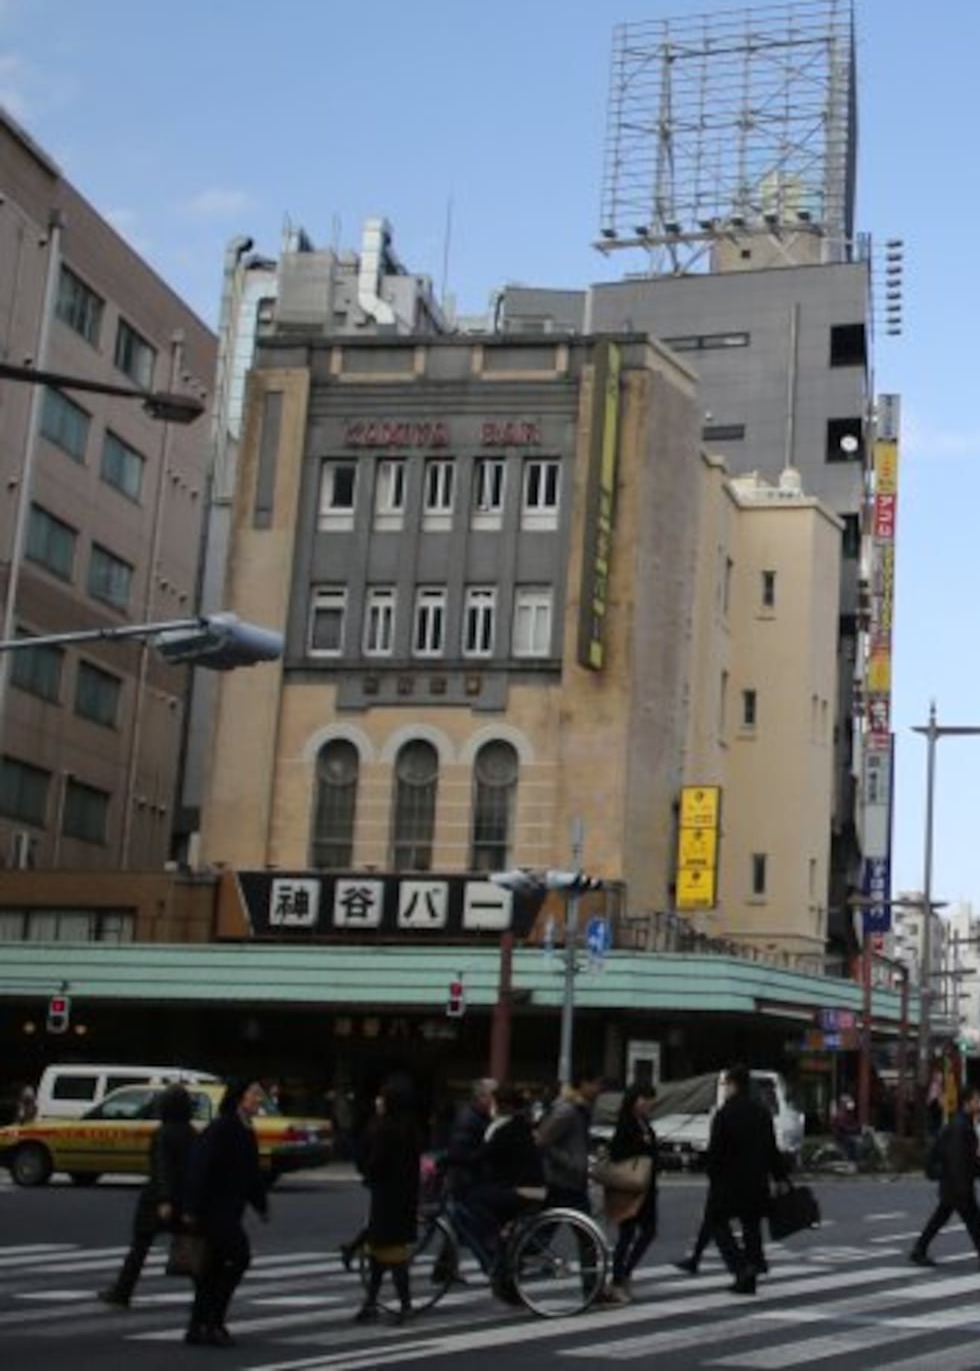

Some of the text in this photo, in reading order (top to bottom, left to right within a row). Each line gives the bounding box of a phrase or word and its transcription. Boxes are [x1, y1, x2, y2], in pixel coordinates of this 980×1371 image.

[345, 420, 542, 448] KAMIYA BAR
[274, 884, 504, 919] 神谷バー
